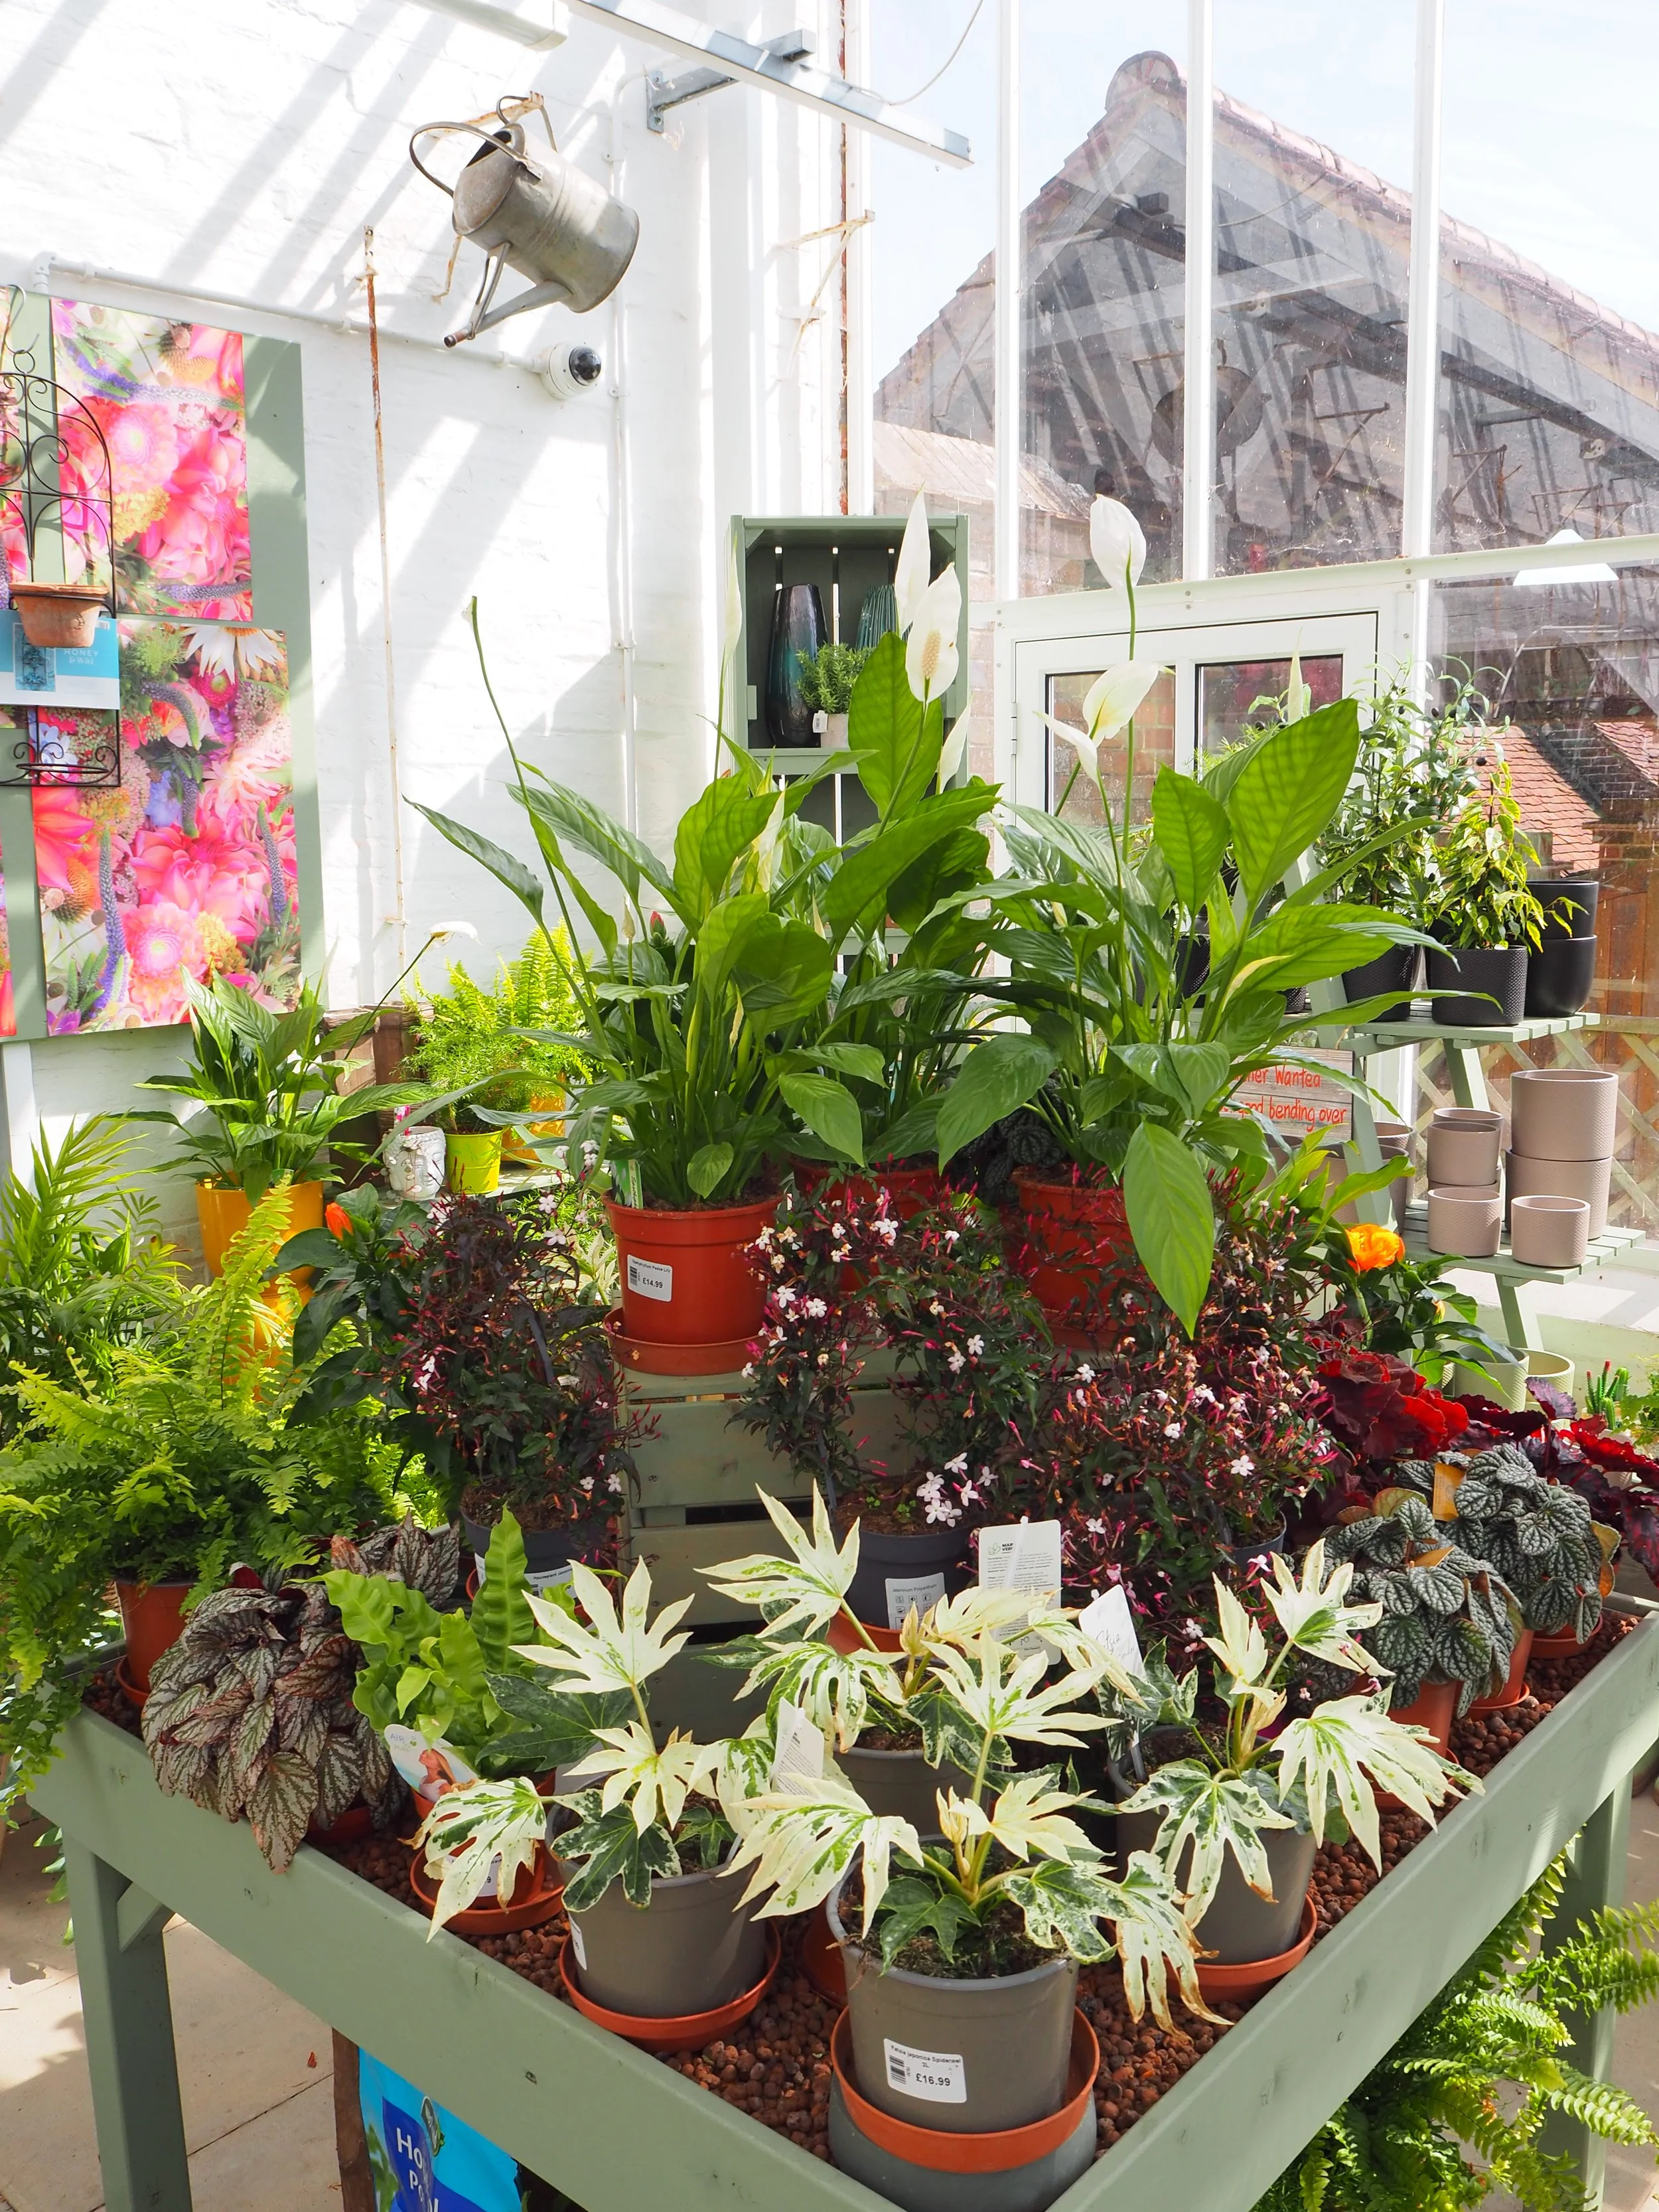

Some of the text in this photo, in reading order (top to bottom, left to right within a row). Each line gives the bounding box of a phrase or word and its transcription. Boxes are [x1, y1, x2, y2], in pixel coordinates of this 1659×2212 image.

[1269, 1096, 1315, 1132] bending
[1319, 1106, 1347, 1124] over
[642, 1278, 663, 1289] £14.99
[916, 2073, 951, 2087] £16.99
